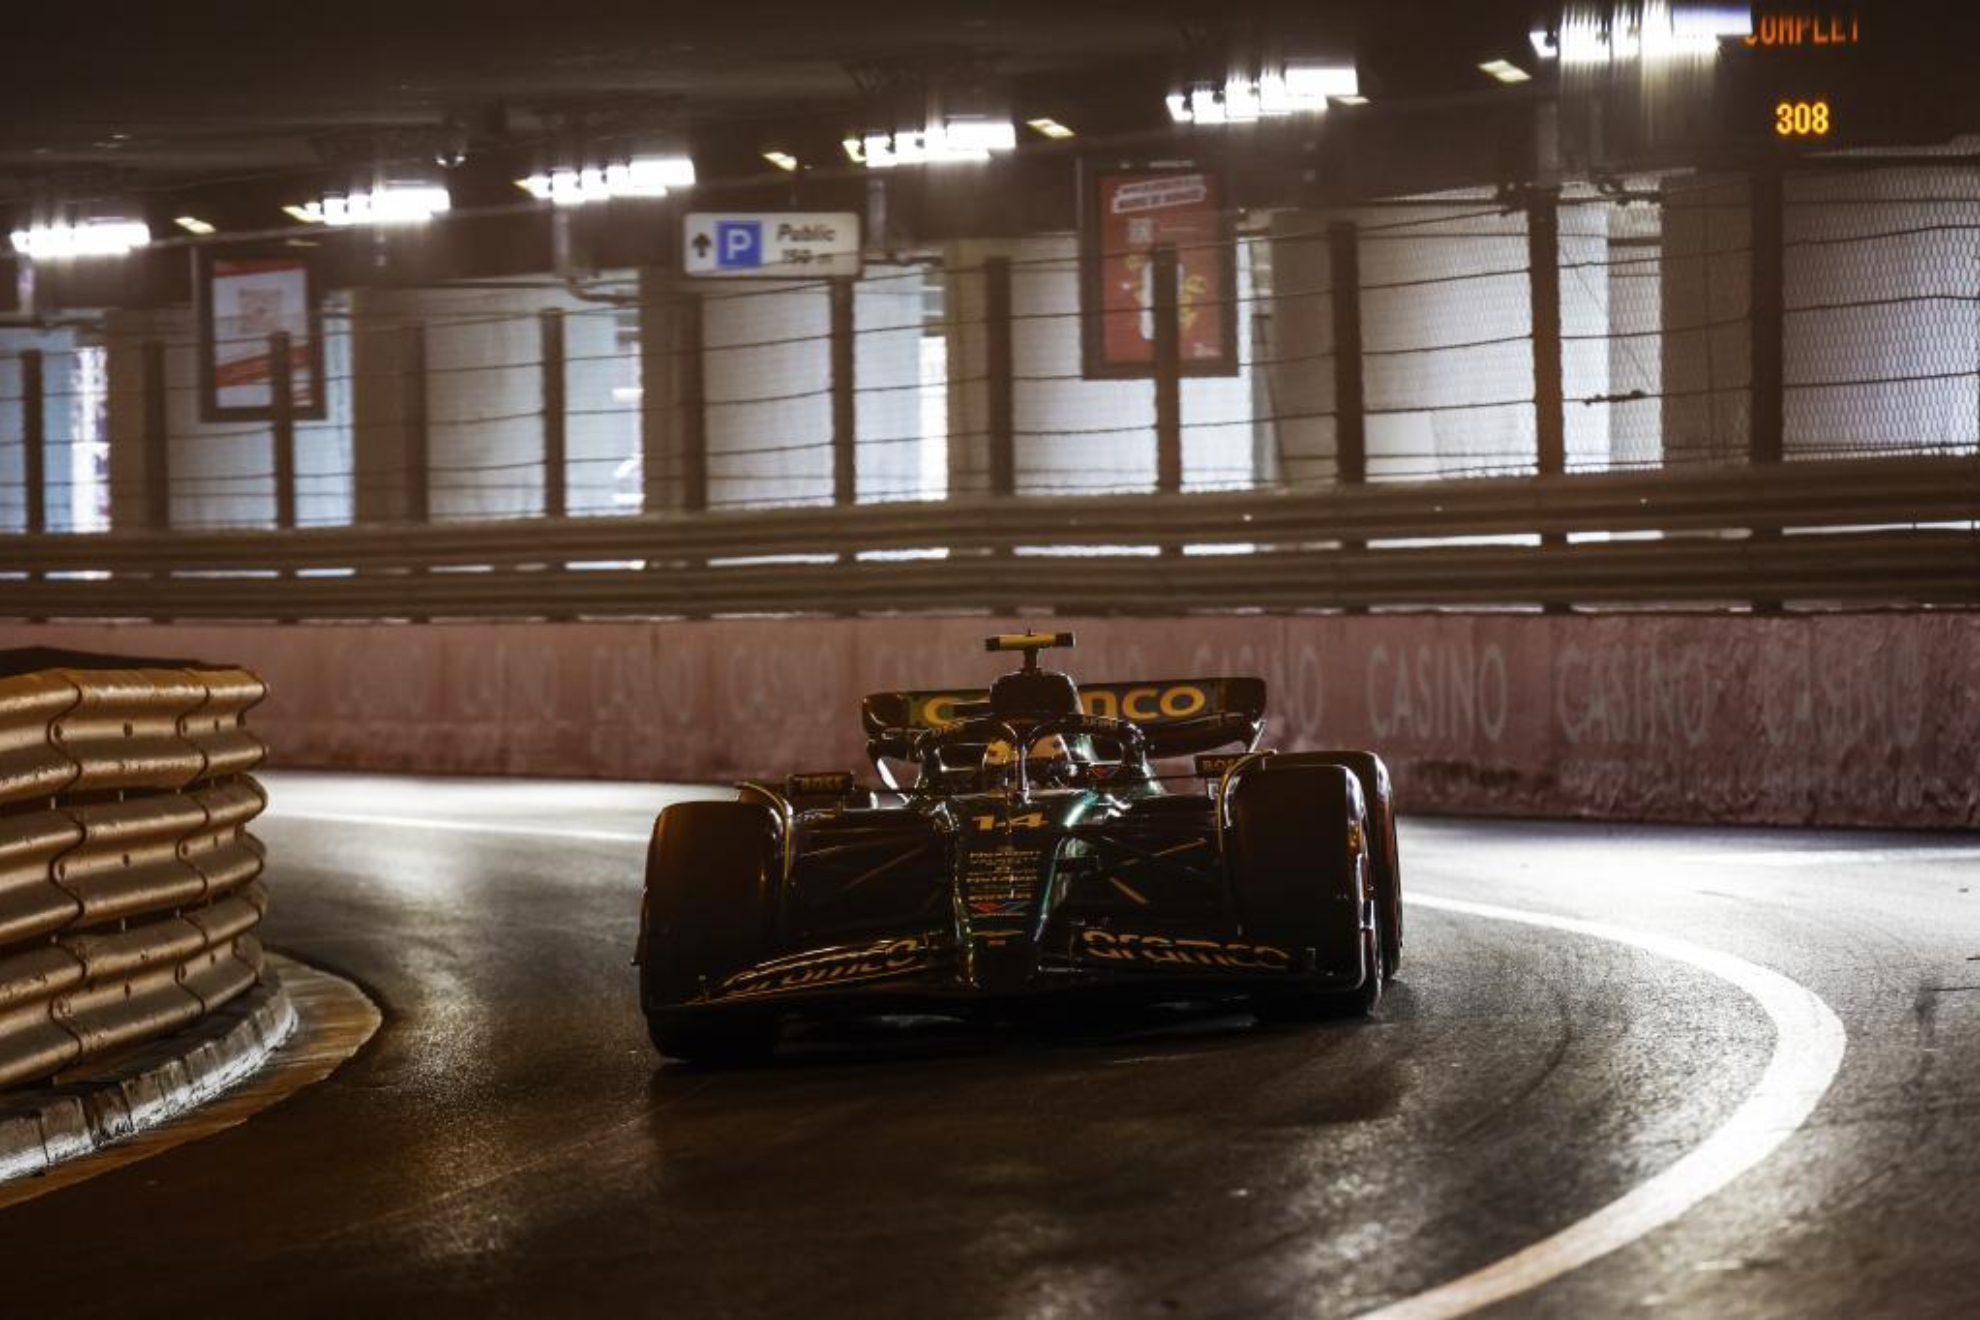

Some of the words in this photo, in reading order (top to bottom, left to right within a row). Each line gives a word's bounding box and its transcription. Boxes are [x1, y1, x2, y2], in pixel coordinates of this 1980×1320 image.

[1776, 102, 1830, 135] 308
[726, 229, 752, 260] P
[776, 223, 837, 242] Public
[1367, 642, 1507, 743] CASINO
[1556, 643, 1710, 748] CASINO
[971, 812, 1050, 831] 14
